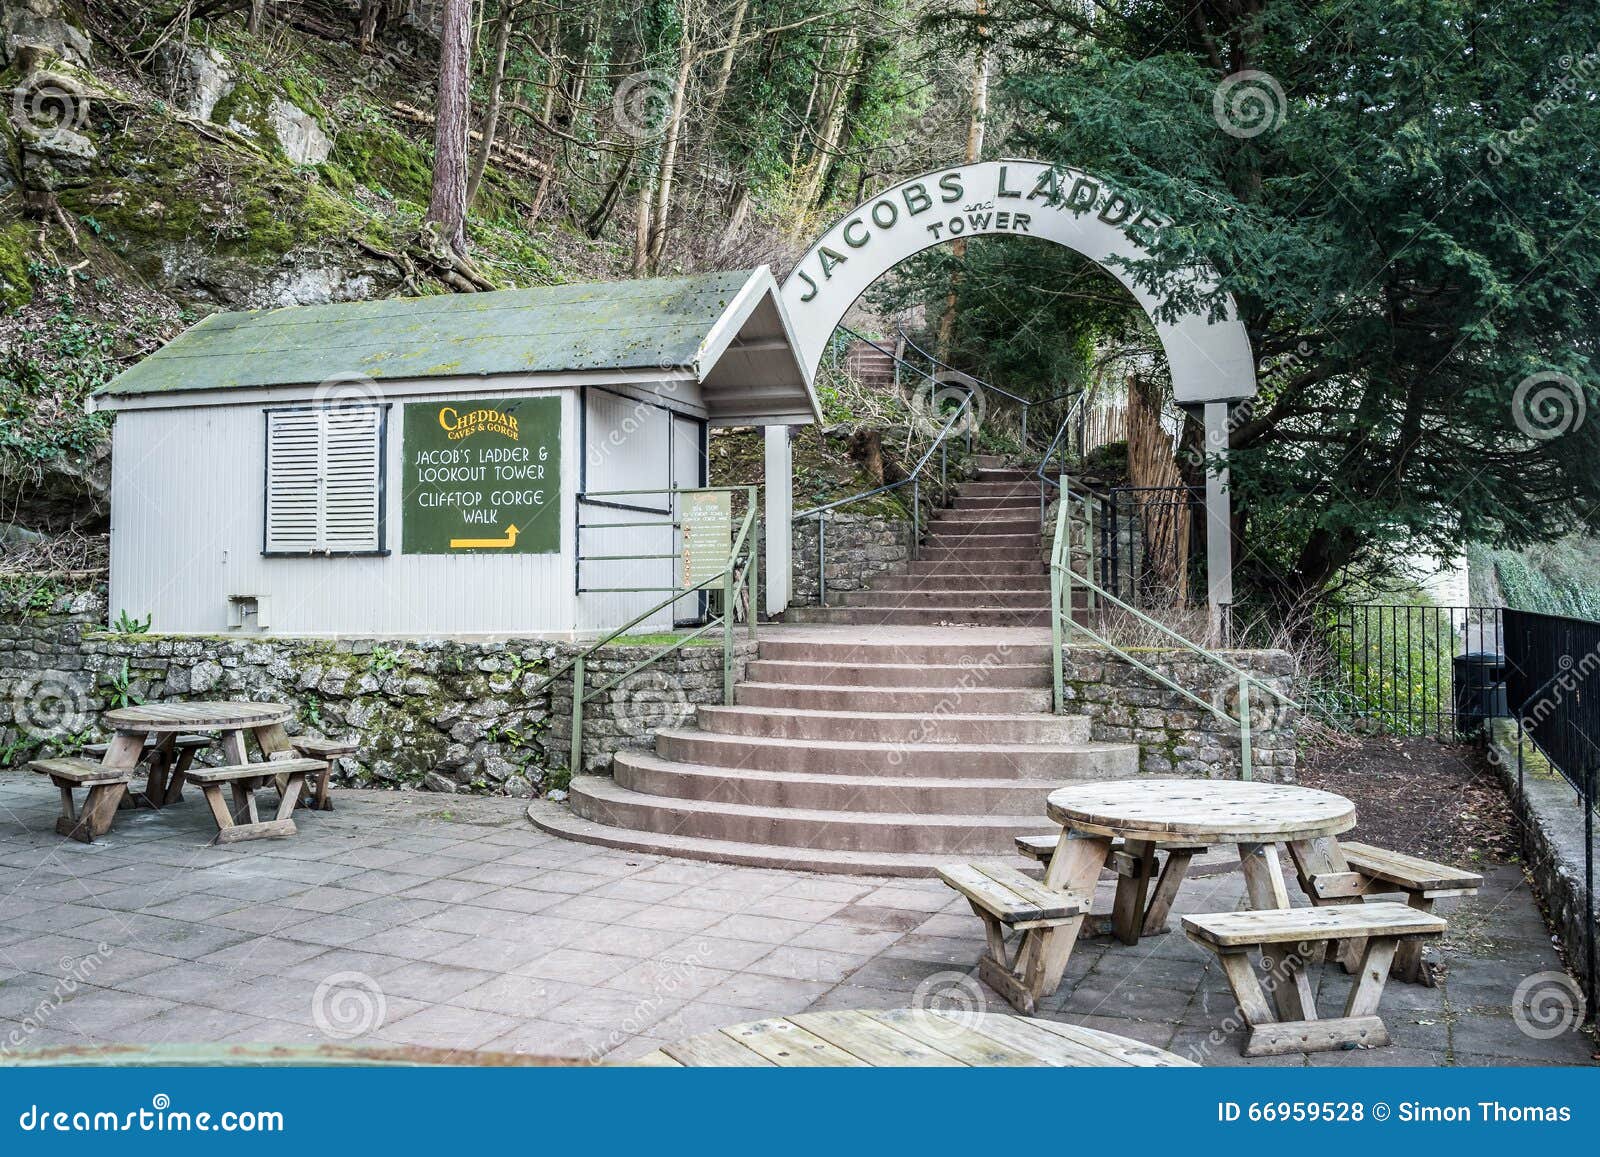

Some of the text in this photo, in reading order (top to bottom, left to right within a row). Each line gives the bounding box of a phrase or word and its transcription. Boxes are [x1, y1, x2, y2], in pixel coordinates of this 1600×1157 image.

[798, 166, 1161, 302] JACOBS LADDE
[927, 212, 1032, 240] TOWER
[438, 407, 519, 431] CHEDDAR
[448, 423, 519, 440] CAVES & GORGE
[415, 446, 548, 465] JACOB'S LADDER &
[418, 465, 544, 482] LOOKOUT TOWER
[418, 490, 544, 507] CLIFFTOP GORGE
[463, 509, 498, 524] WALK
